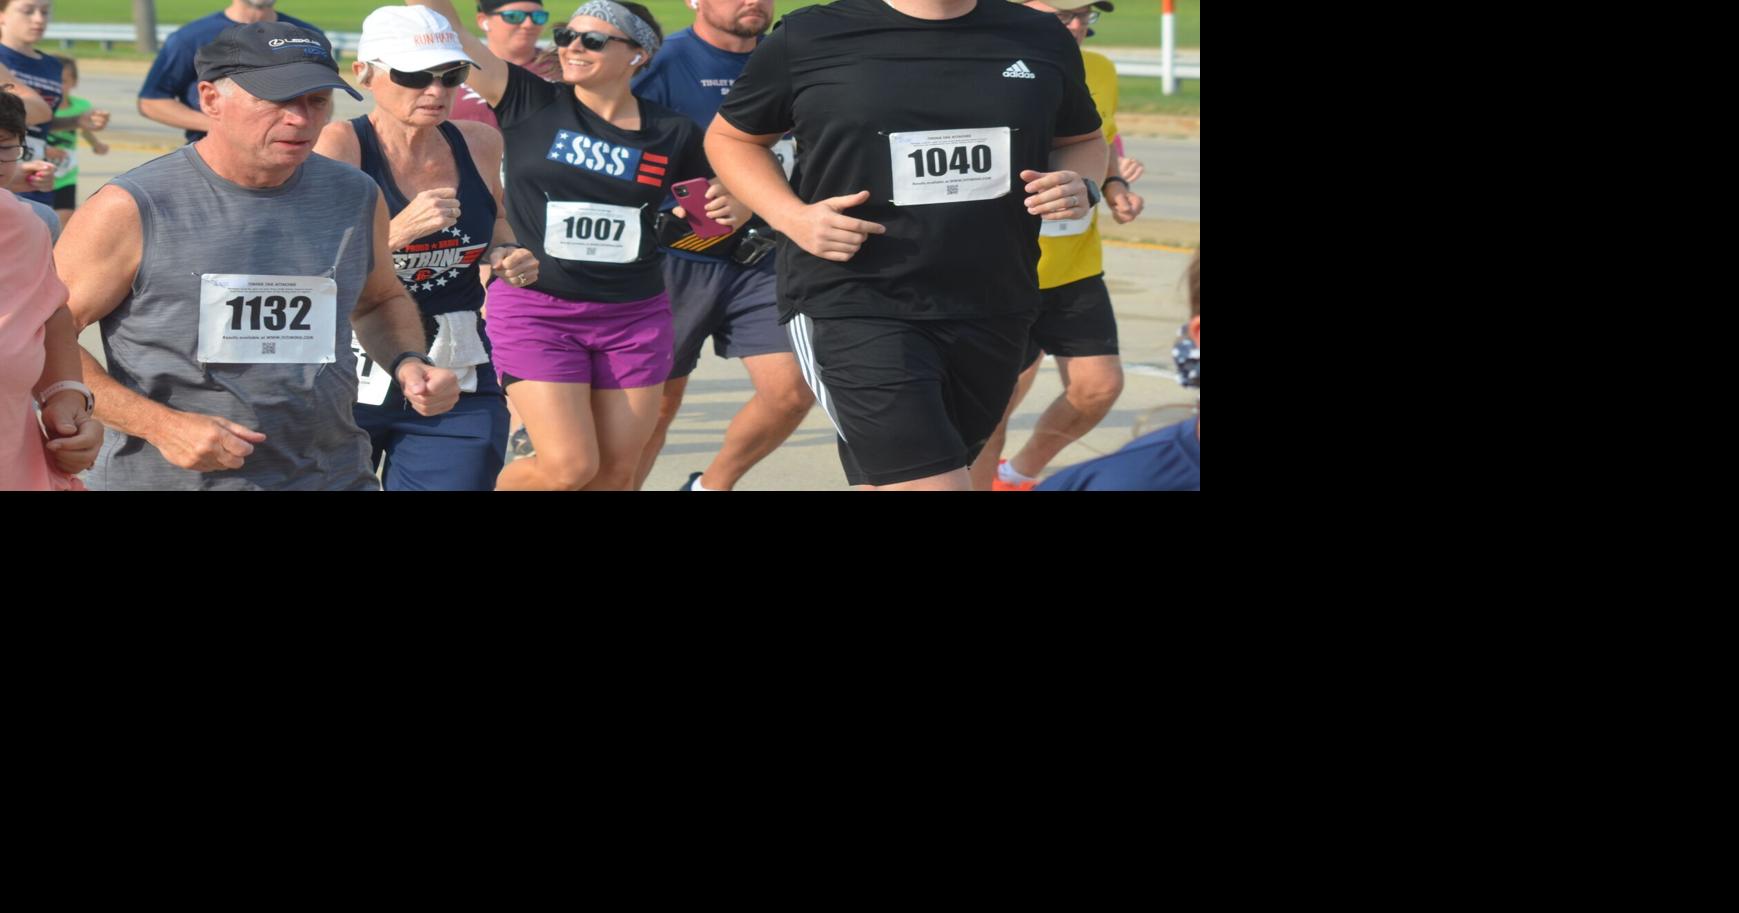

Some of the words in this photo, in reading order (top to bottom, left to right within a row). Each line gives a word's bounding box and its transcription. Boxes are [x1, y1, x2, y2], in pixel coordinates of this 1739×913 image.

[1002, 71, 1036, 79] adidas
[565, 136, 629, 176] SSS
[908, 144, 992, 178] 1040
[563, 216, 626, 241] 1007
[226, 295, 312, 331] 1132
